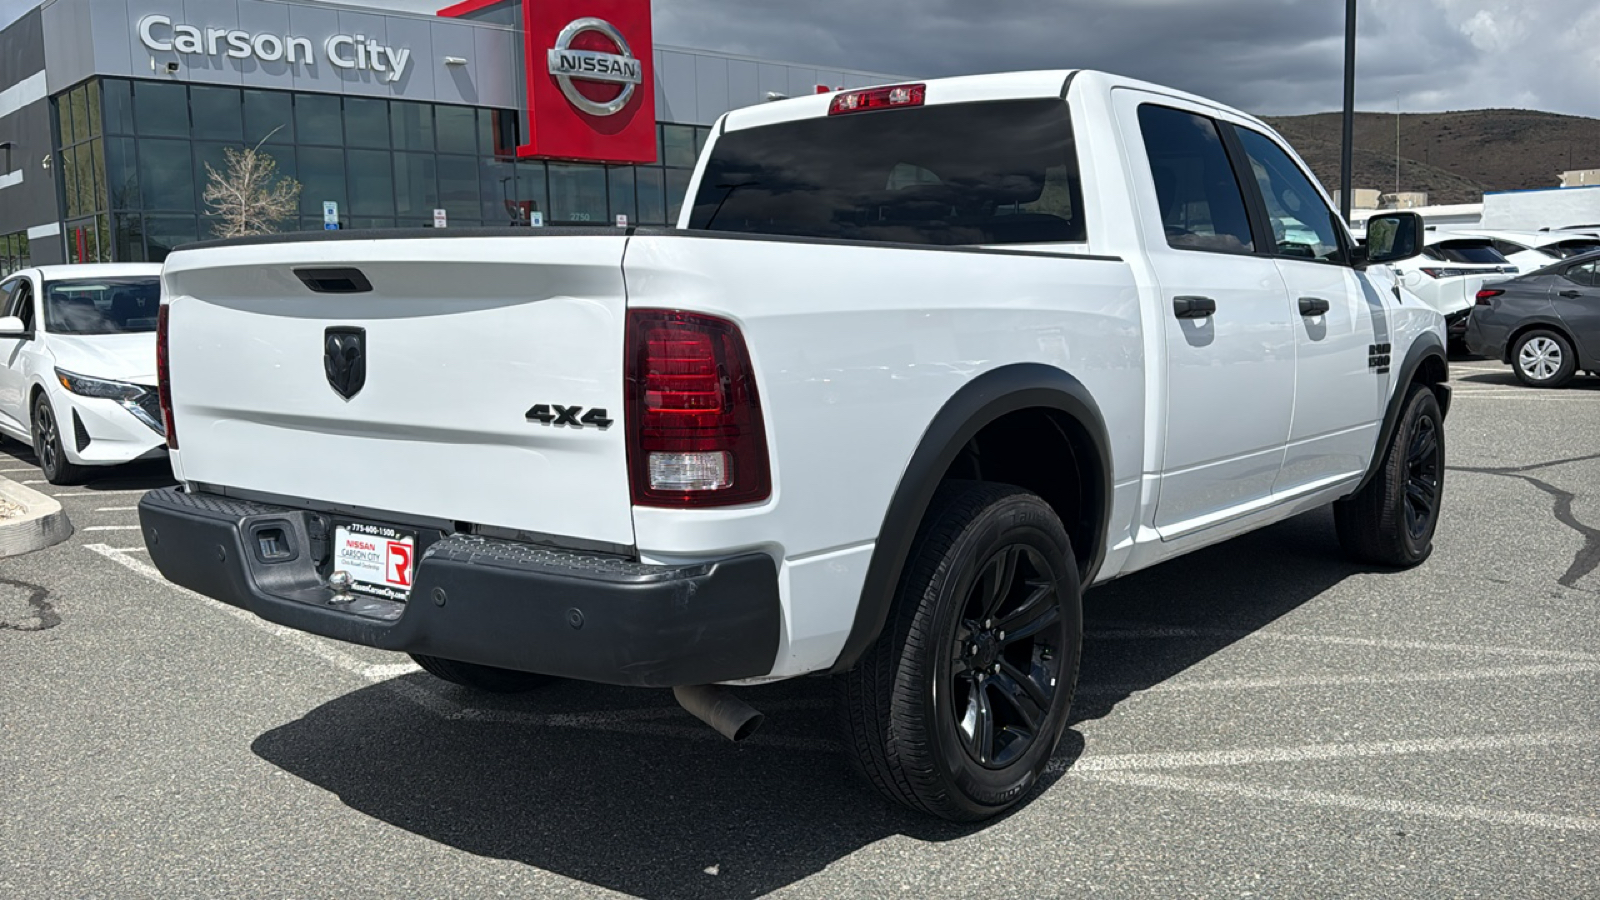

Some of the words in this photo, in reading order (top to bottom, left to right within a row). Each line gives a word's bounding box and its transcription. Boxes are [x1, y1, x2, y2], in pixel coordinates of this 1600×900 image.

[138, 14, 314, 65] Carson
[325, 34, 411, 81] City
[560, 54, 636, 77] NISSAN
[341, 548, 366, 559] CARSON
[367, 552, 380, 561] CITY
[346, 539, 376, 551] NISSAN
[389, 544, 410, 586] R
